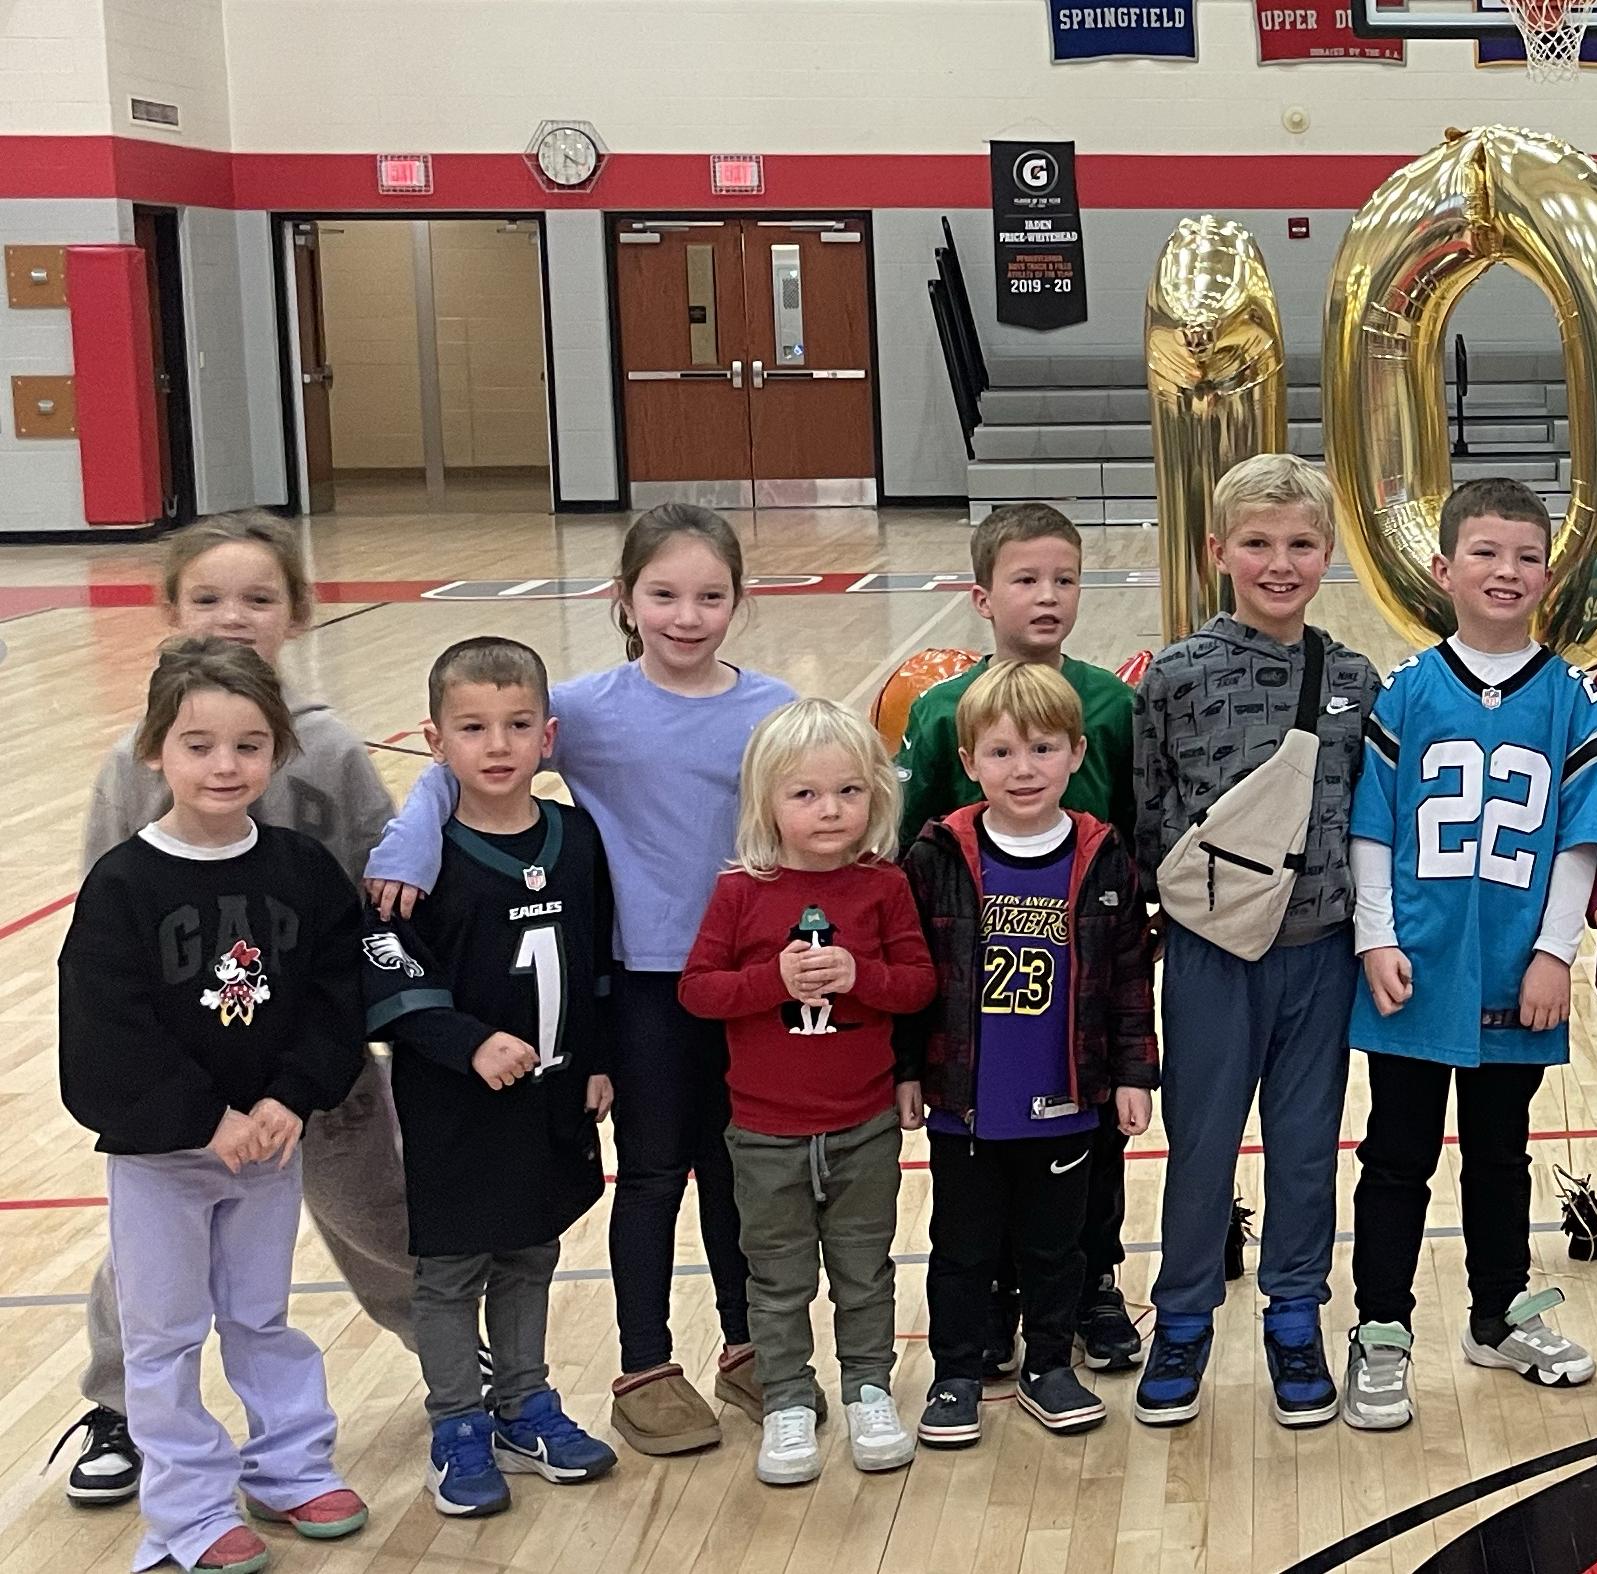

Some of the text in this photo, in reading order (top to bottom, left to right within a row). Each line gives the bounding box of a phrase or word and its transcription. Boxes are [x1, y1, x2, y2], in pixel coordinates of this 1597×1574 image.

[1059, 7, 1185, 30] SPRINGFIELD
[1261, 9, 1318, 30] UPPER
[1022, 158, 1048, 187] G
[1010, 279, 1041, 293] 2019
[1053, 278, 1072, 293] 20
[1416, 739, 1552, 890] 22
[509, 900, 563, 921] EAGLES
[995, 895, 1069, 910] LOS ANGEL
[158, 894, 300, 985] GAP
[981, 945, 1055, 1015] 23
[511, 922, 570, 1081] 1
